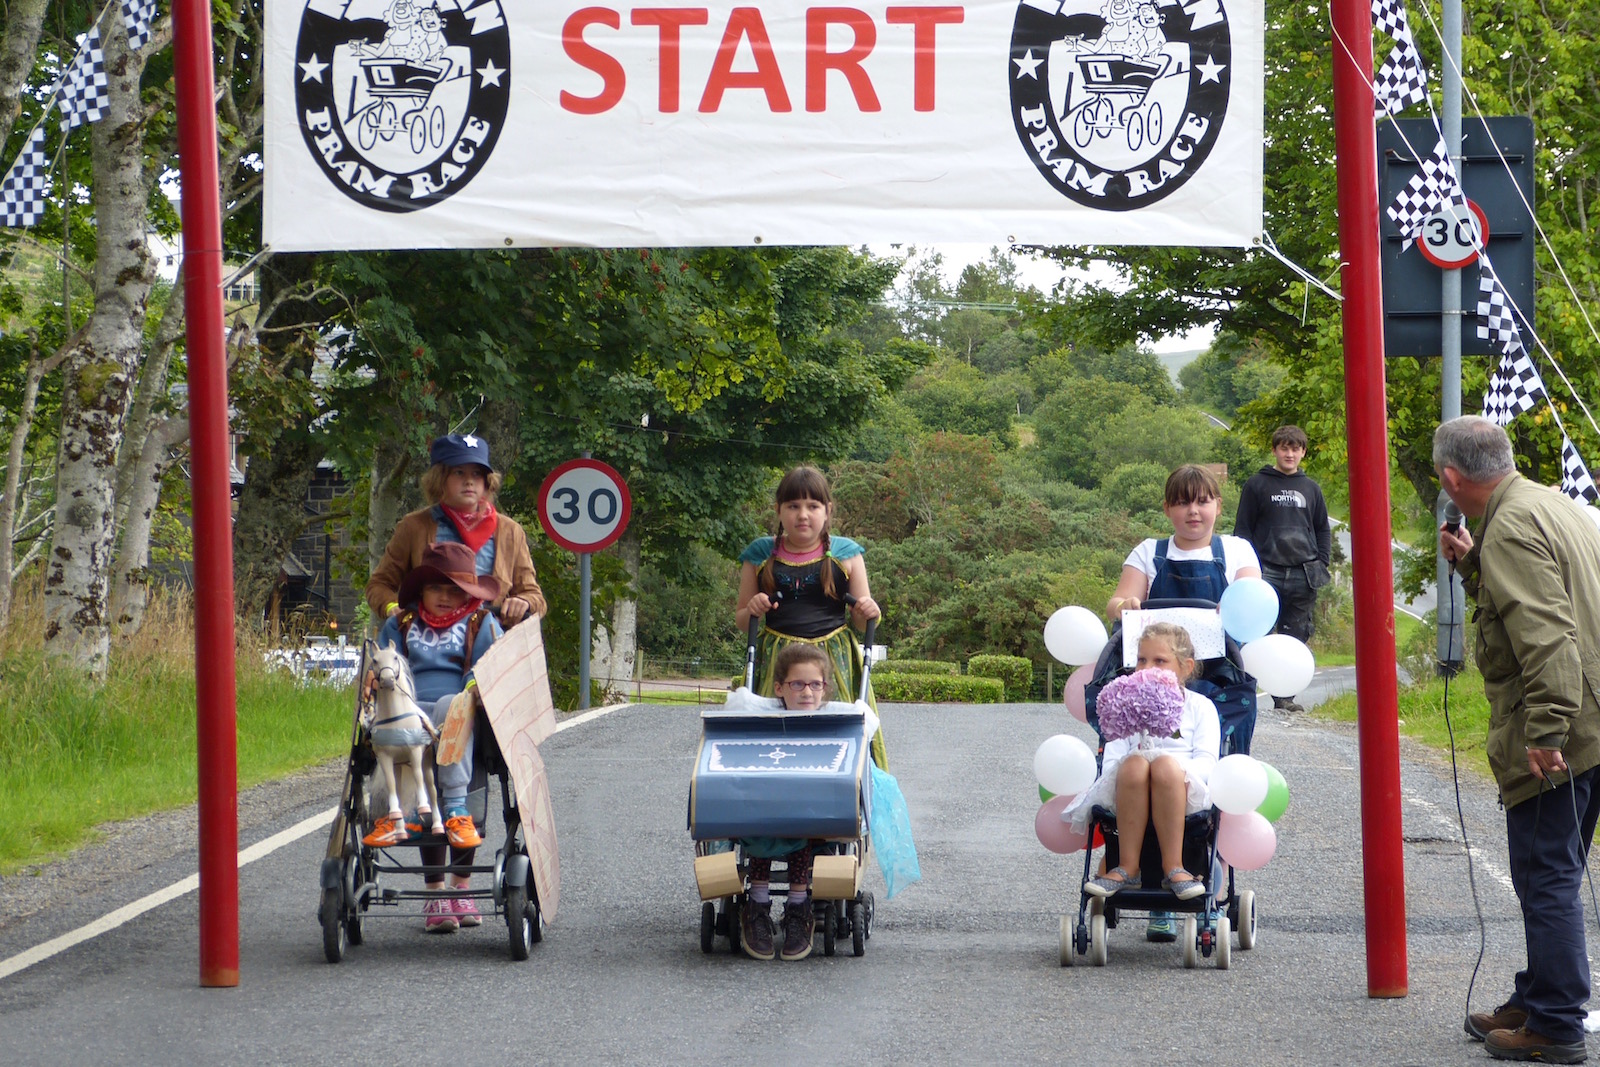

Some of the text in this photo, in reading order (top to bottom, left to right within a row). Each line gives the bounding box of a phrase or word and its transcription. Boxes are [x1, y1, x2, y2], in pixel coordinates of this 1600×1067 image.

[559, 5, 965, 115] START
[305, 106, 491, 200] PRAM RACE
[1020, 102, 1210, 198] PRAM RACE
[1426, 217, 1478, 247] 30
[552, 487, 618, 525] 30
